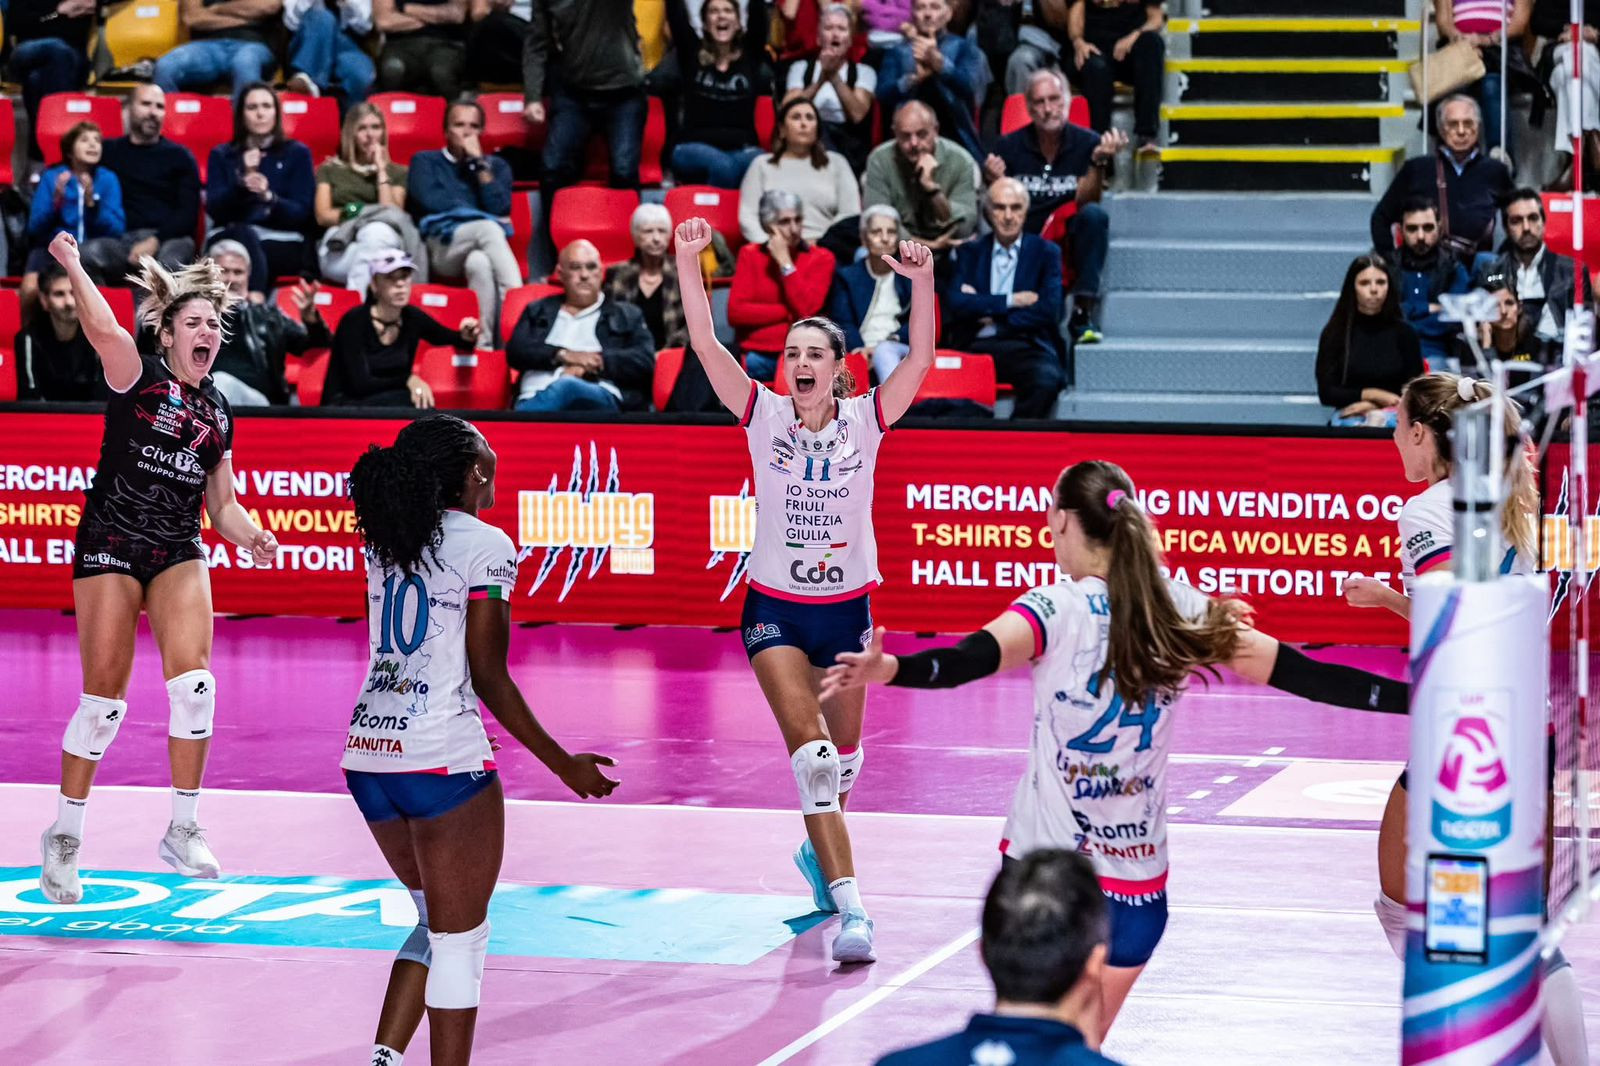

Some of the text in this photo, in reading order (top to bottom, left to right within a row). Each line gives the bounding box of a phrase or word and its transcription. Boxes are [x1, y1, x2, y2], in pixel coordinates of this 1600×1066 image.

[156, 414, 182, 428] VENEZIA
[157, 408, 176, 419] FRIULI
[153, 420, 175, 432] GIULIA
[189, 419, 211, 451] 7
[137, 461, 175, 478] GRUPPO
[802, 455, 831, 480] 11
[786, 483, 850, 499] IO SONO
[785, 499, 825, 512] FRIULI
[1178, 490, 1209, 516] IN
[1216, 490, 1351, 519] VENDITA
[1355, 494, 1402, 521] OG
[267, 509, 357, 533] WOLVE
[519, 491, 653, 547] WOLVES
[786, 513, 843, 526] VENEZIA
[786, 528, 831, 541] GIULIA
[911, 522, 1032, 548] T-SHIRTS
[1231, 530, 1347, 557] WOLVES
[1353, 534, 1373, 558] A
[235, 543, 355, 571] STTORI
[911, 559, 989, 586] HALL
[1198, 566, 1324, 596] SETTORI
[376, 571, 429, 656] 10
[1066, 668, 1160, 754] 24
[347, 735, 403, 753] ZANUTTA
